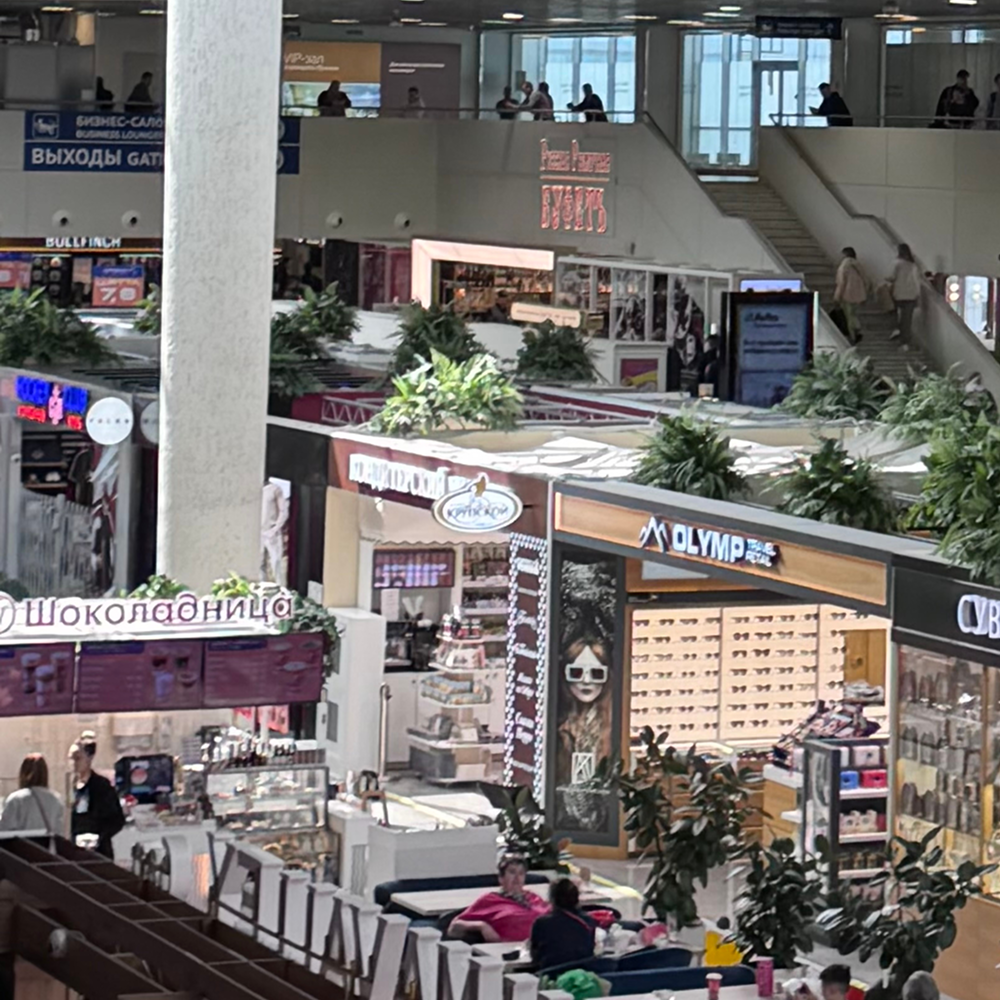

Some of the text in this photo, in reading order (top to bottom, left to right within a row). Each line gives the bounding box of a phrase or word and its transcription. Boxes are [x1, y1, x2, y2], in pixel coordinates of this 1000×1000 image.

[76, 115, 164, 128] БИЗНЕС-САЛО
[31, 148, 122, 168] ВЫХОДЫ
[672, 523, 745, 563] OLYMP
[24, 592, 294, 628] Шоколадница
